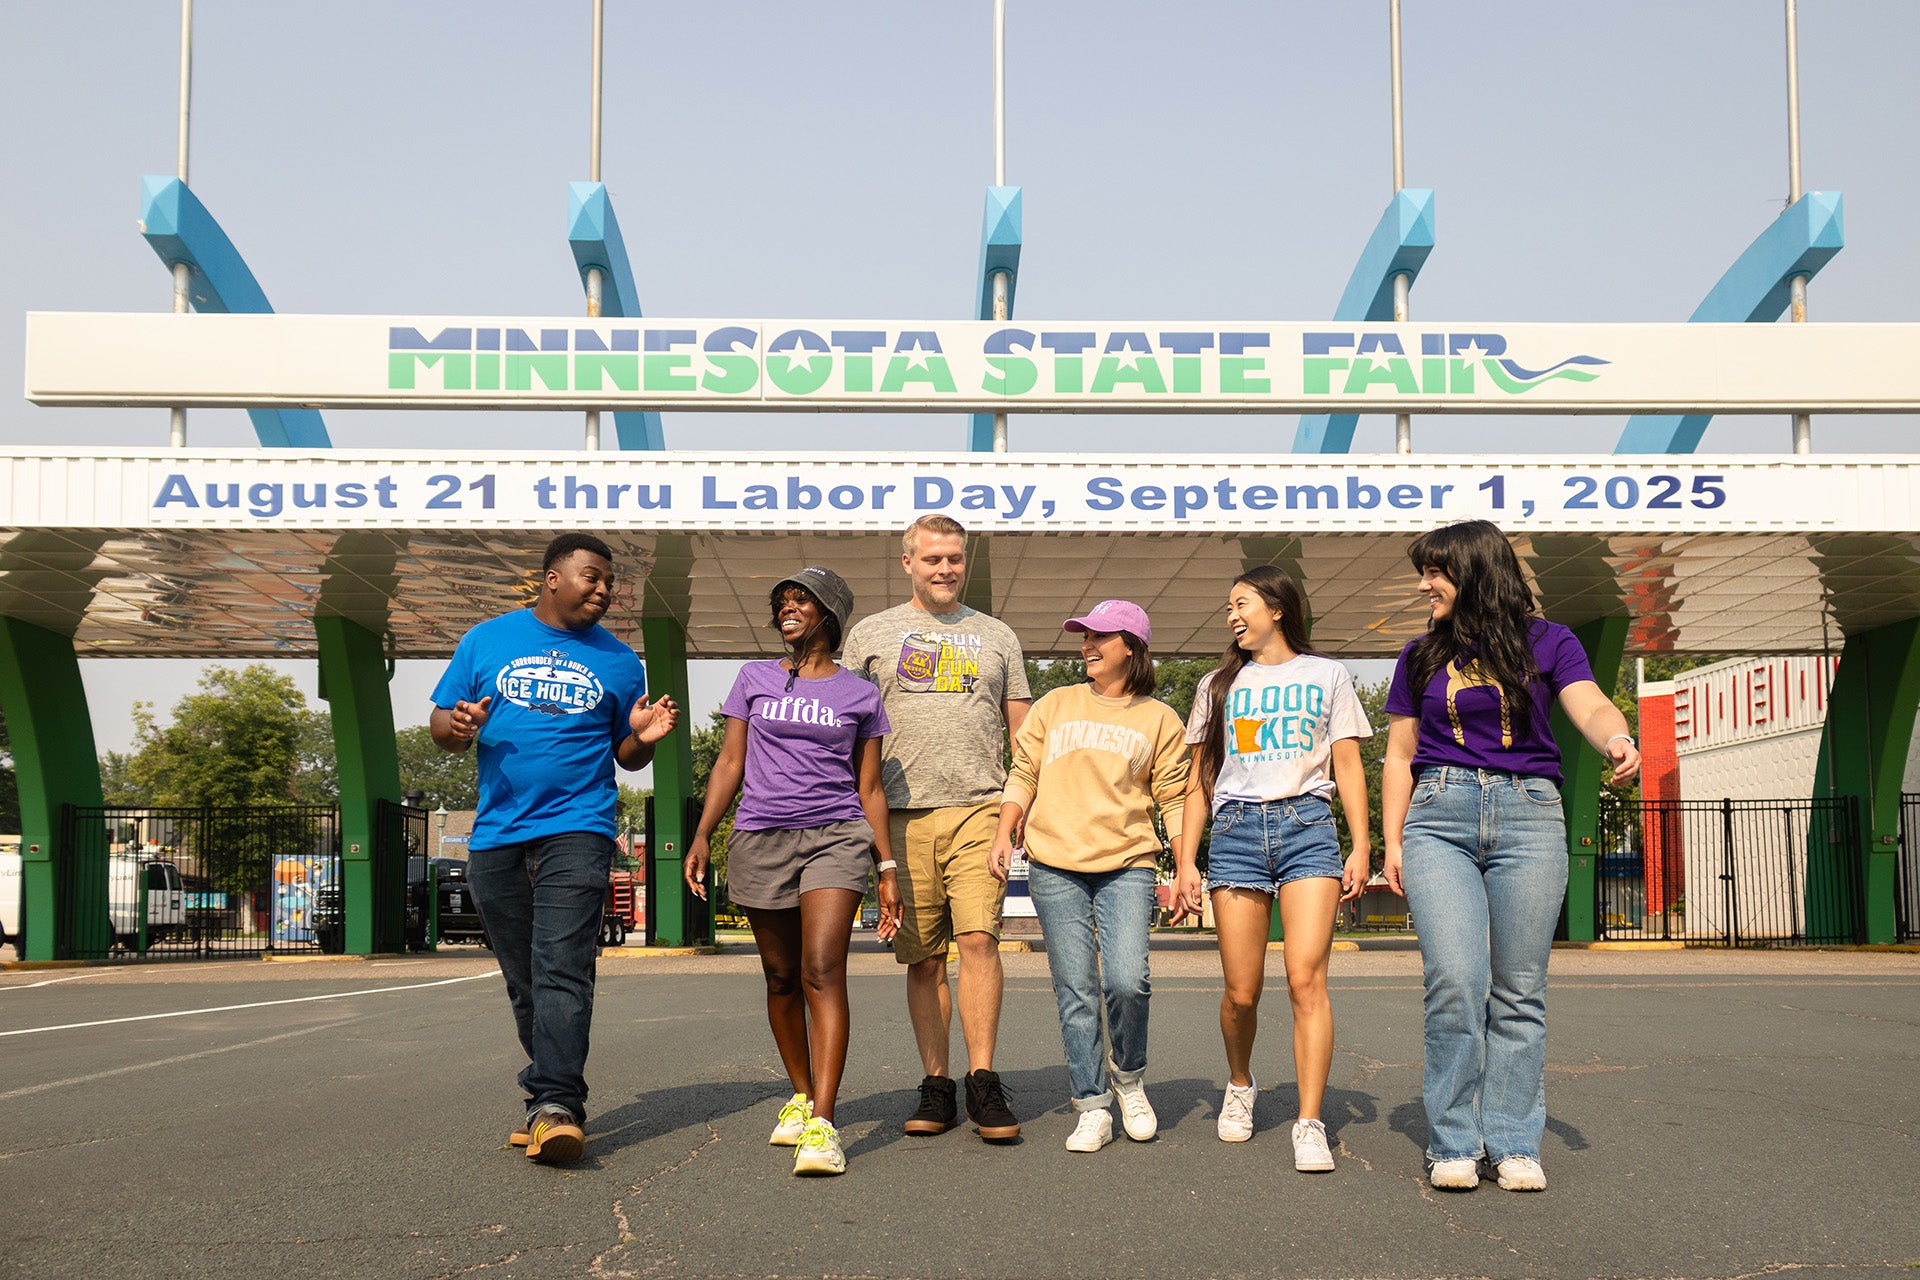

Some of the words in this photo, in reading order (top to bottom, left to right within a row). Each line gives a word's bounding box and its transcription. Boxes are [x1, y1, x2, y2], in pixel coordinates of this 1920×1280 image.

[388, 326, 957, 395] MINNESOTA
[981, 328, 1271, 396] STATE
[1302, 332, 1613, 395] FAIR
[153, 473, 397, 518] August
[425, 474, 496, 510] 21
[533, 475, 672, 510] thru
[702, 475, 896, 510] Labor
[912, 476, 1056, 519] Day,
[1085, 475, 1453, 519] September
[1477, 475, 1537, 518] 1,
[1562, 474, 1726, 510] 2025
[941, 633, 981, 646] SUN
[941, 645, 981, 660] DAY
[511, 656, 552, 668] SURROUNDED
[567, 661, 589, 675] BUNCH
[938, 659, 978, 676] FUN
[502, 677, 533, 699] ICE
[536, 682, 599, 710] HOLES
[1225, 683, 1323, 721] 10,000
[761, 696, 836, 727] uffda
[1229, 715, 1316, 756] LKES
[1240, 750, 1305, 764] MINNESOTA
